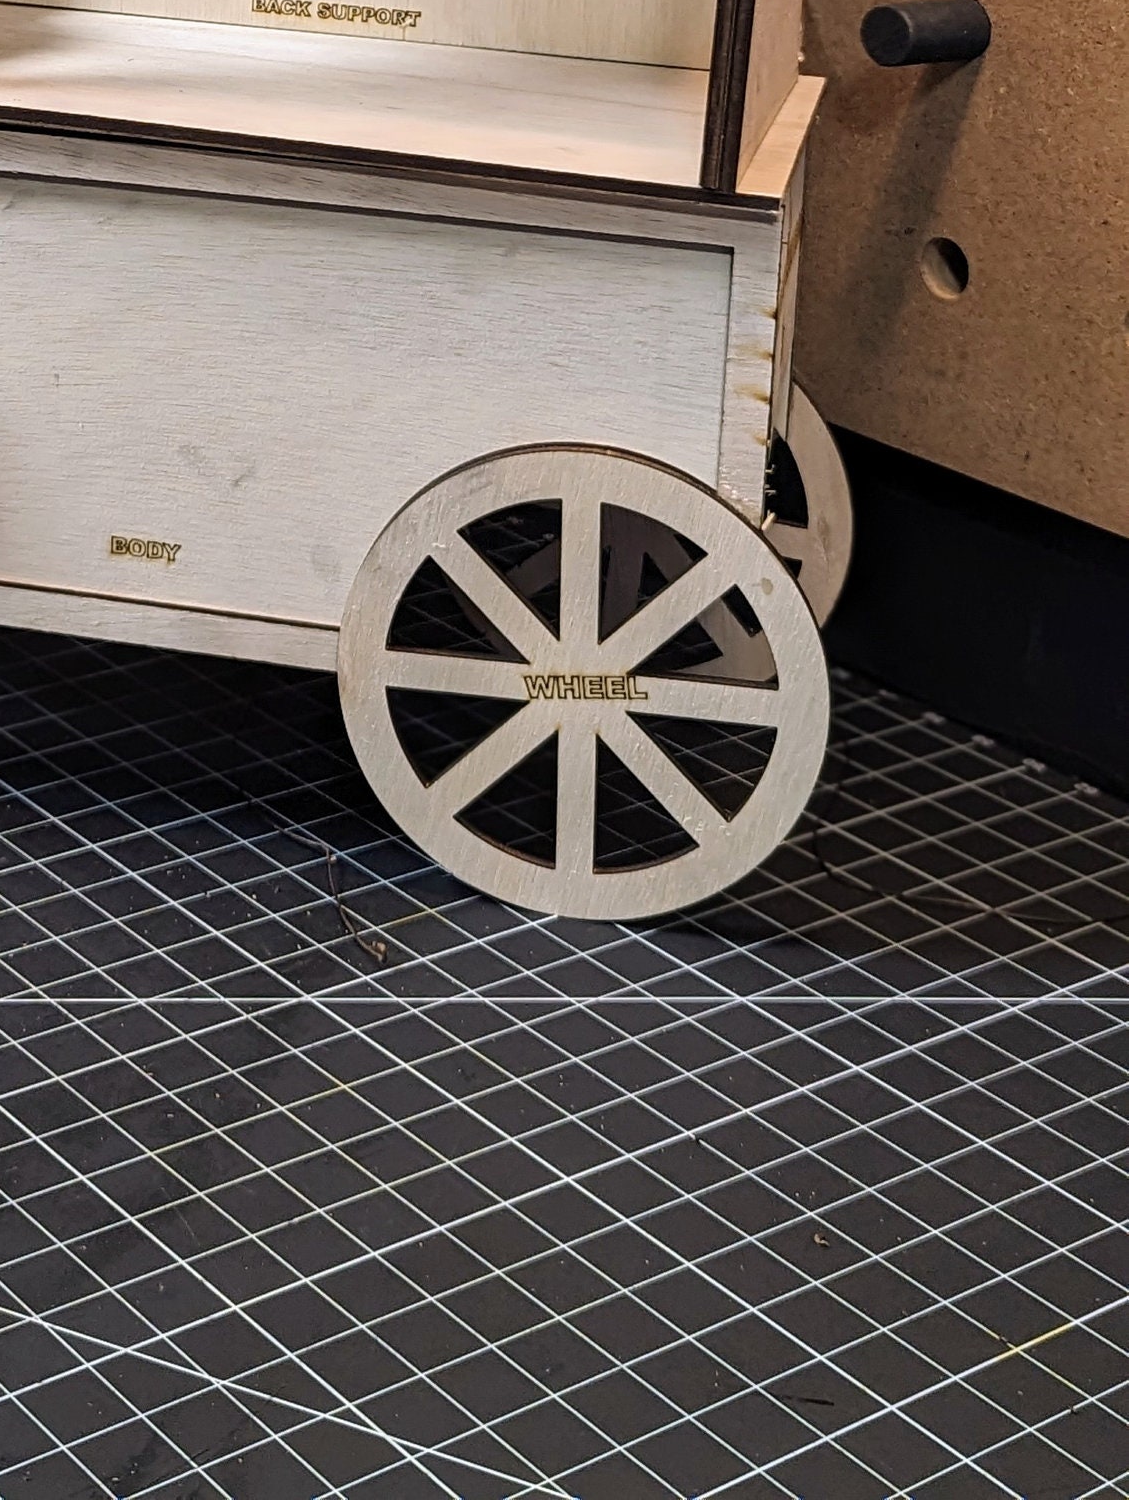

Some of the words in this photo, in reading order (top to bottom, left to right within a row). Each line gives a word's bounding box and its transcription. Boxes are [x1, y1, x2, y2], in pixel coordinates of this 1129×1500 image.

[317, 2, 422, 27] SUPPORT
[110, 535, 182, 562] BODY
[523, 674, 649, 700] WHEEL
